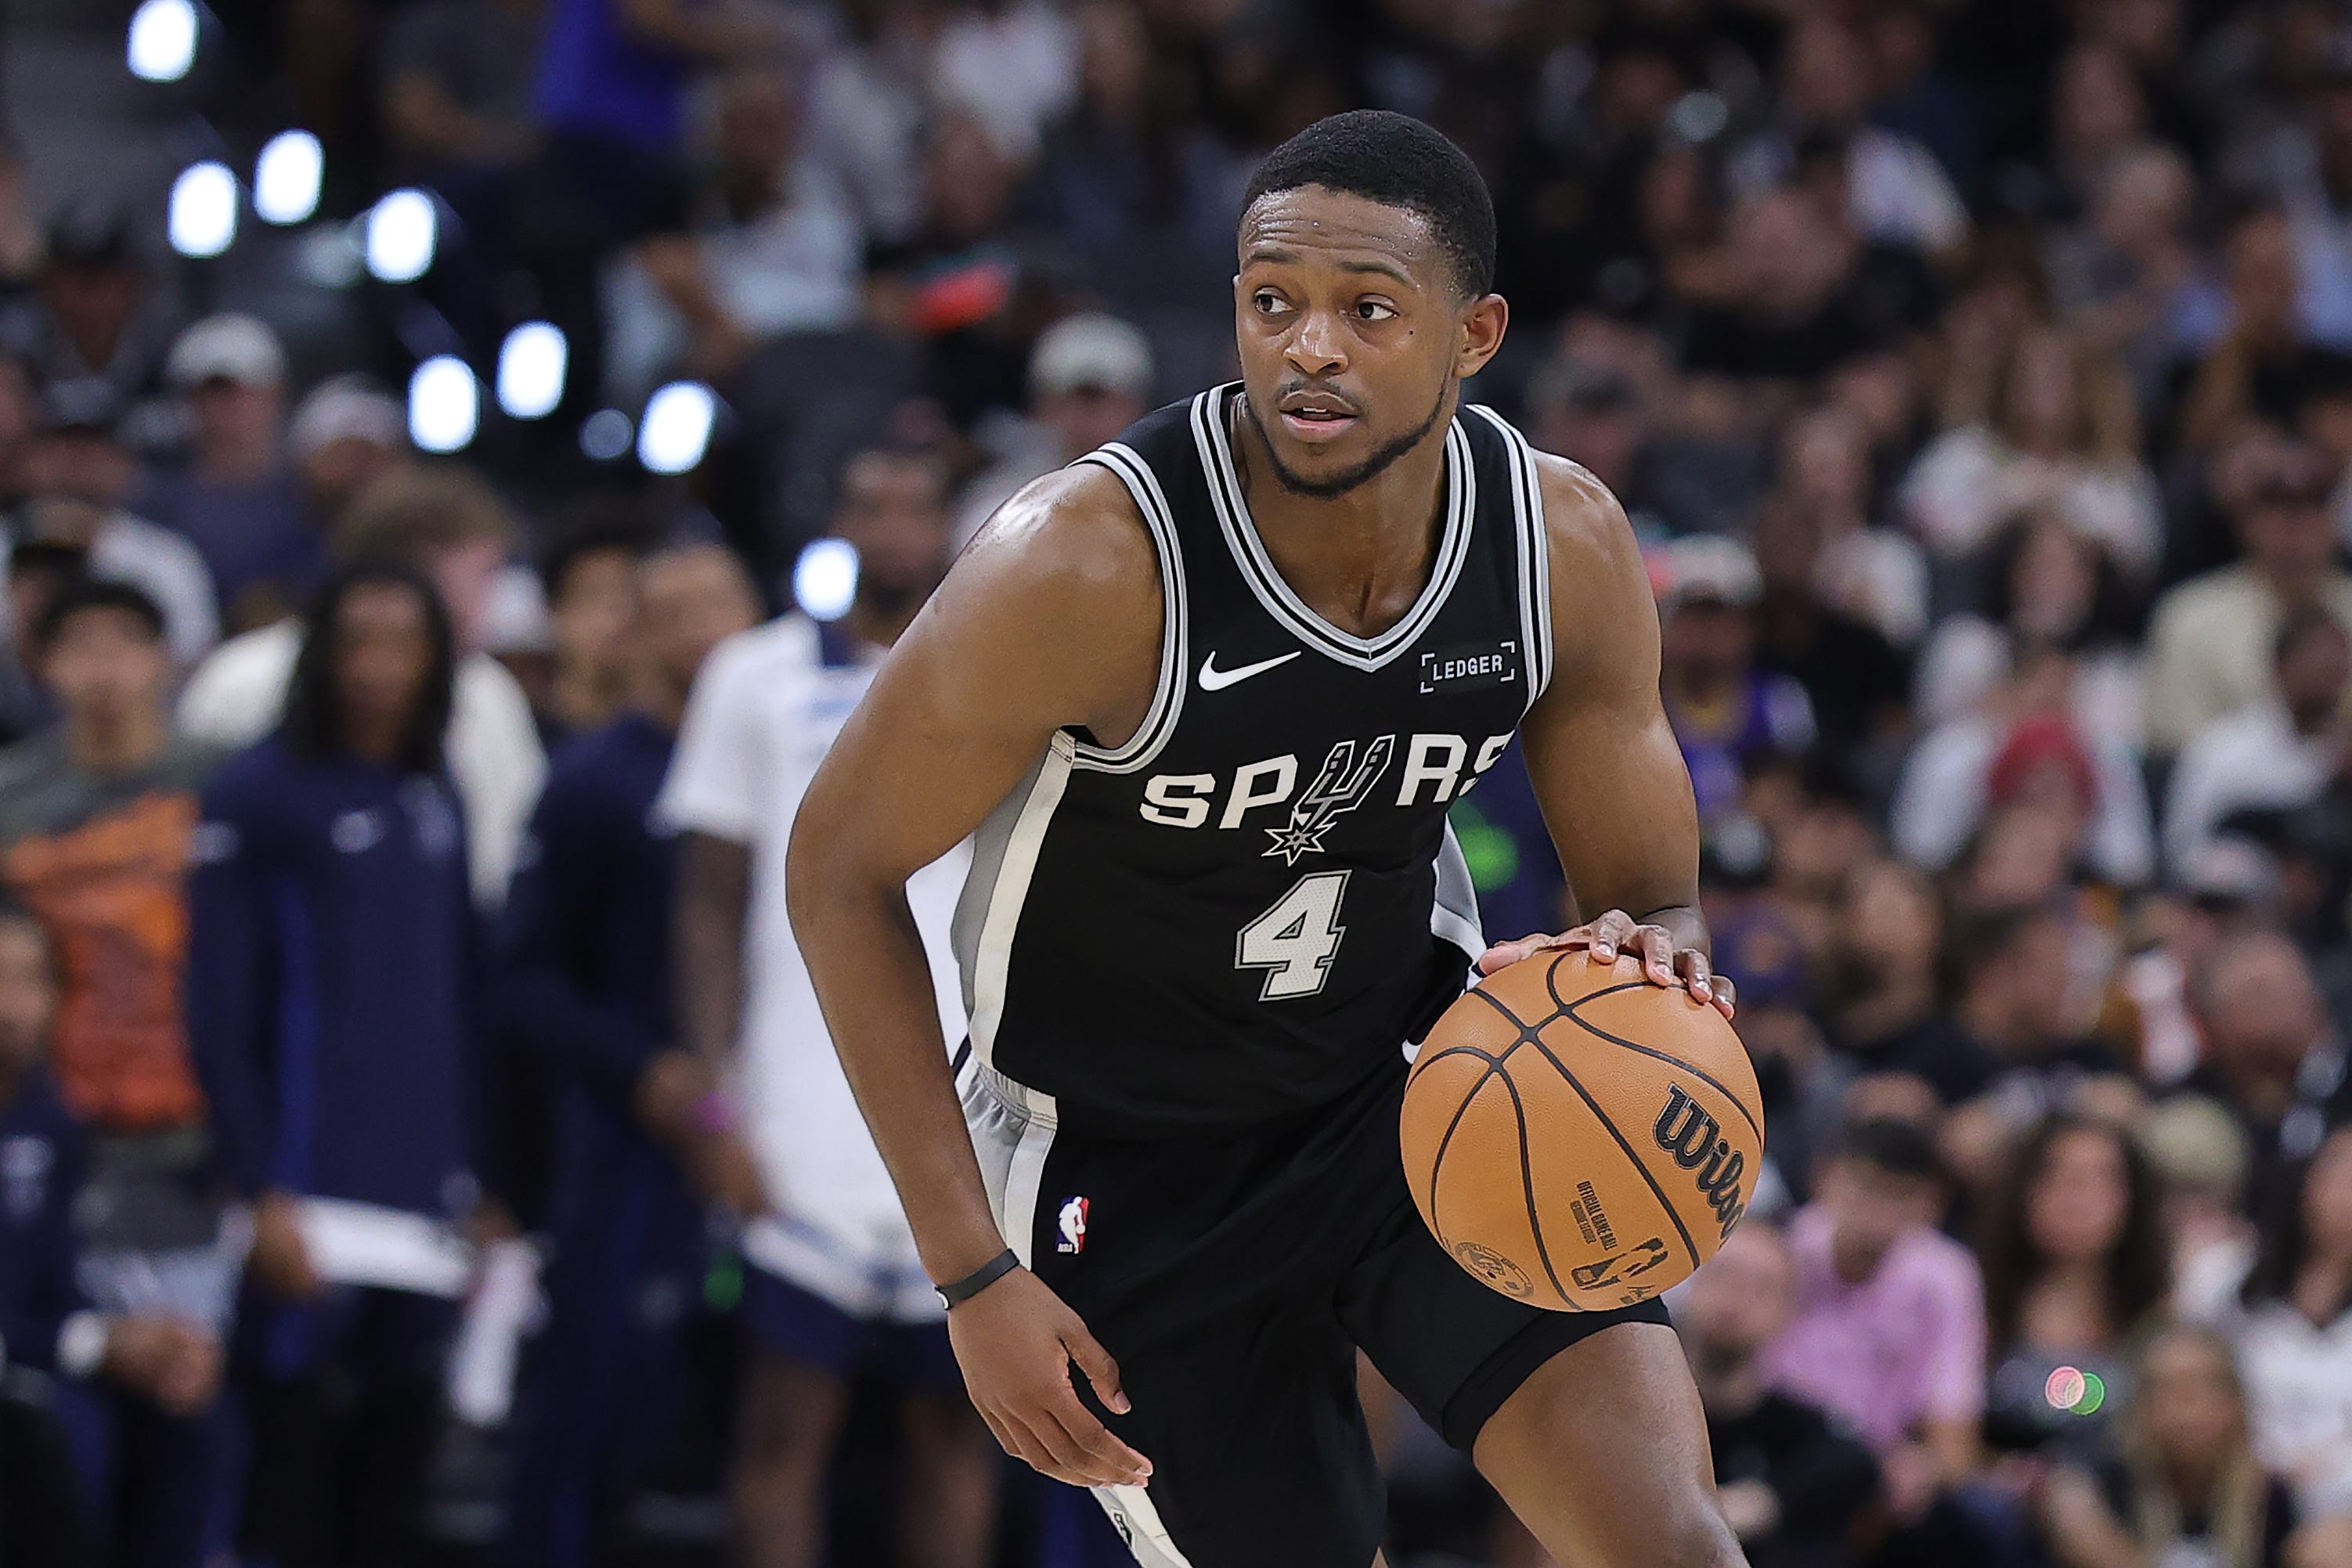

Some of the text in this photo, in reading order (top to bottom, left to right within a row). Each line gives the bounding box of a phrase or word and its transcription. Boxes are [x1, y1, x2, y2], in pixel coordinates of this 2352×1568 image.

[1433, 654, 1502, 681] LEDGER
[1234, 869, 1352, 1002] 4
[1577, 1181, 1603, 1217] OFFICIAL
[1653, 1081, 1745, 1251] Wilso
